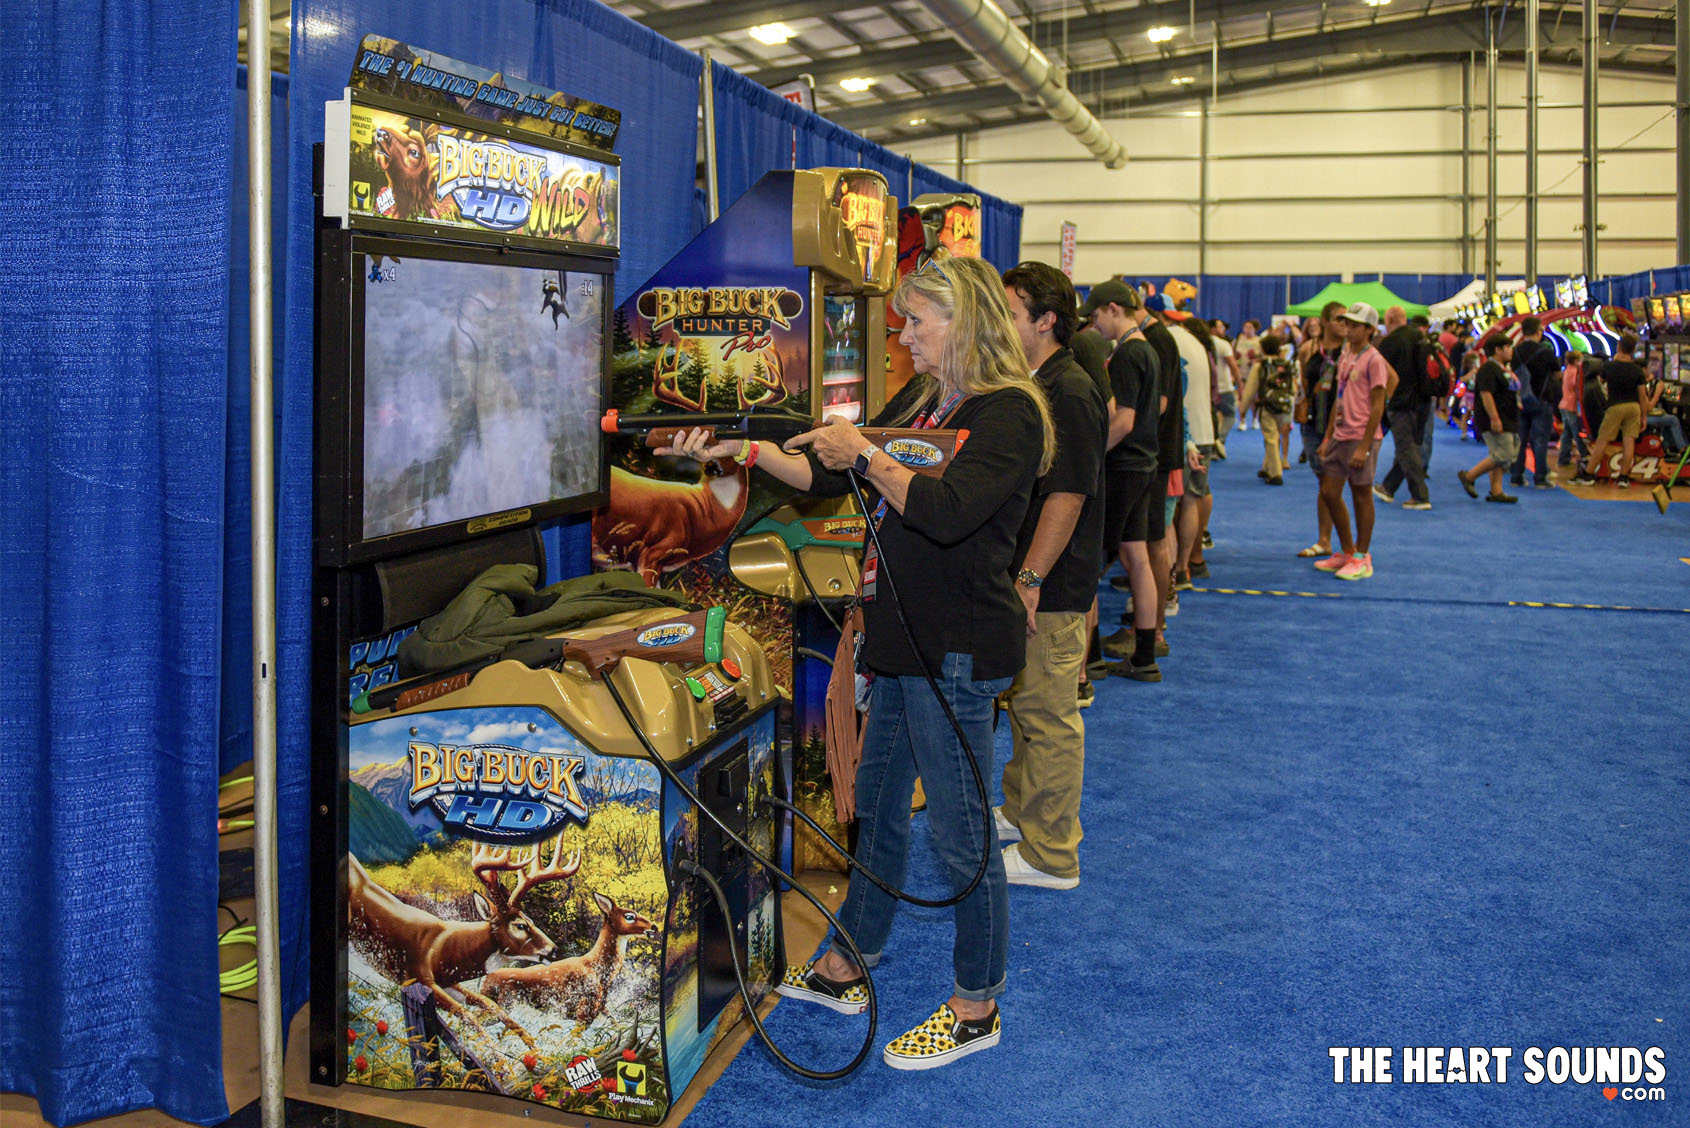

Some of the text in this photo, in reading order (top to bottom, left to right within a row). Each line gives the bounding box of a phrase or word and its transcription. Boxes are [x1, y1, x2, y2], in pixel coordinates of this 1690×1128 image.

[359, 50, 618, 137] THE #1 HUNTING GAME JUST GOT BETTER!
[352, 114, 372, 123] ANIMATED
[352, 122, 371, 130] VIOLENCE
[356, 128, 367, 136] MILD
[439, 136, 546, 196] BIG BUCK
[462, 176, 591, 236] HD WILD
[847, 192, 868, 231] BIG
[653, 287, 790, 329] BIG BUCK
[682, 319, 764, 332] HUNTER
[720, 331, 772, 361] Pro
[891, 441, 938, 461] BIG BUCK
[824, 519, 867, 532] BIG BUCK
[644, 626, 689, 641] BIG BUCK
[410, 743, 588, 812] BIG BUCK
[444, 794, 555, 831] HD
[565, 1057, 597, 1083] RAW
[570, 1070, 602, 1090] THRILLS
